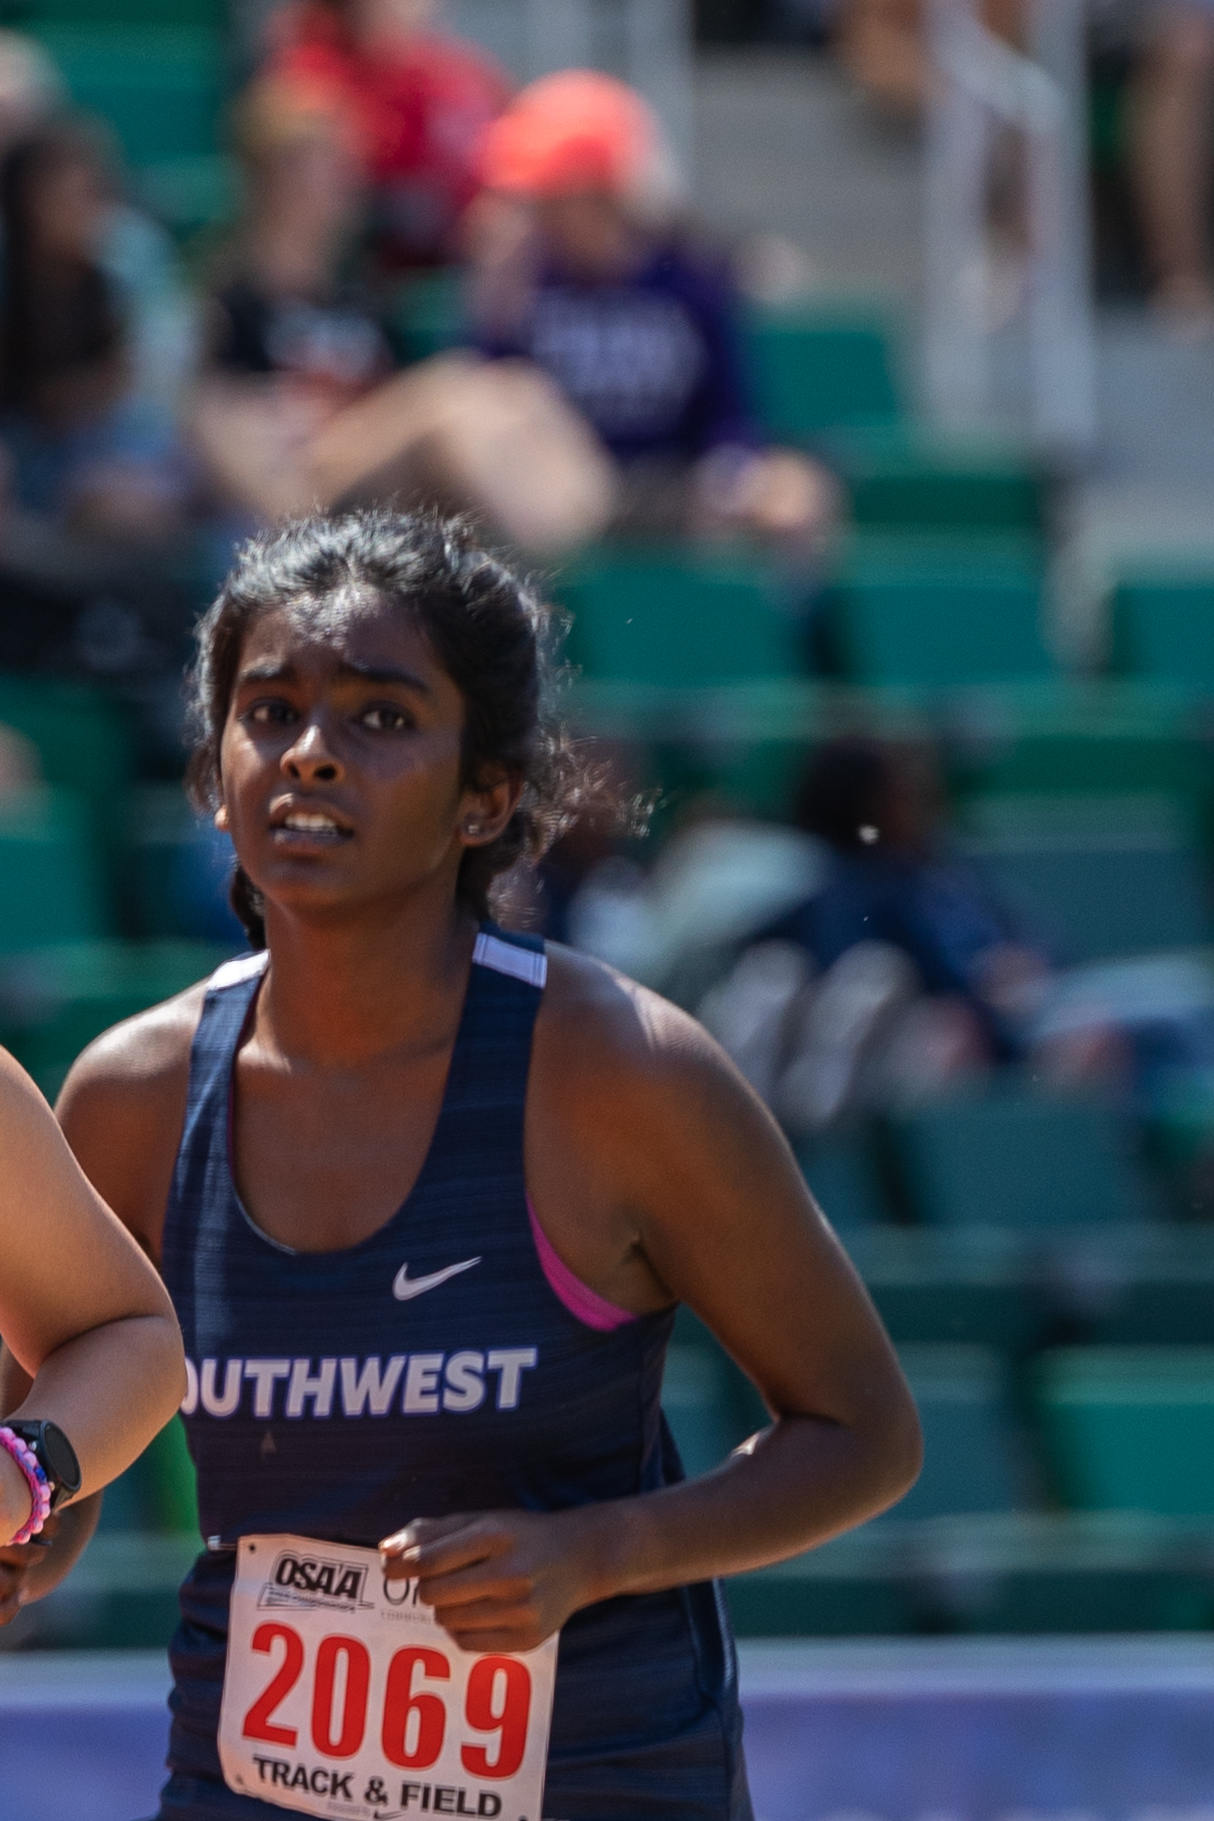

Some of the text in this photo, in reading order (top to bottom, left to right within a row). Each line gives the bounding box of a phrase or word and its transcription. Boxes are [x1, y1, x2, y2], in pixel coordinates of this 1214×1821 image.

[181, 1347, 537, 1417] UTHWEST
[275, 1558, 362, 1599] OSAA
[242, 1618, 533, 1780] 2069
[253, 1753, 354, 1801] TRACK
[364, 1775, 388, 1805] &
[400, 1780, 502, 1820] FIELD
